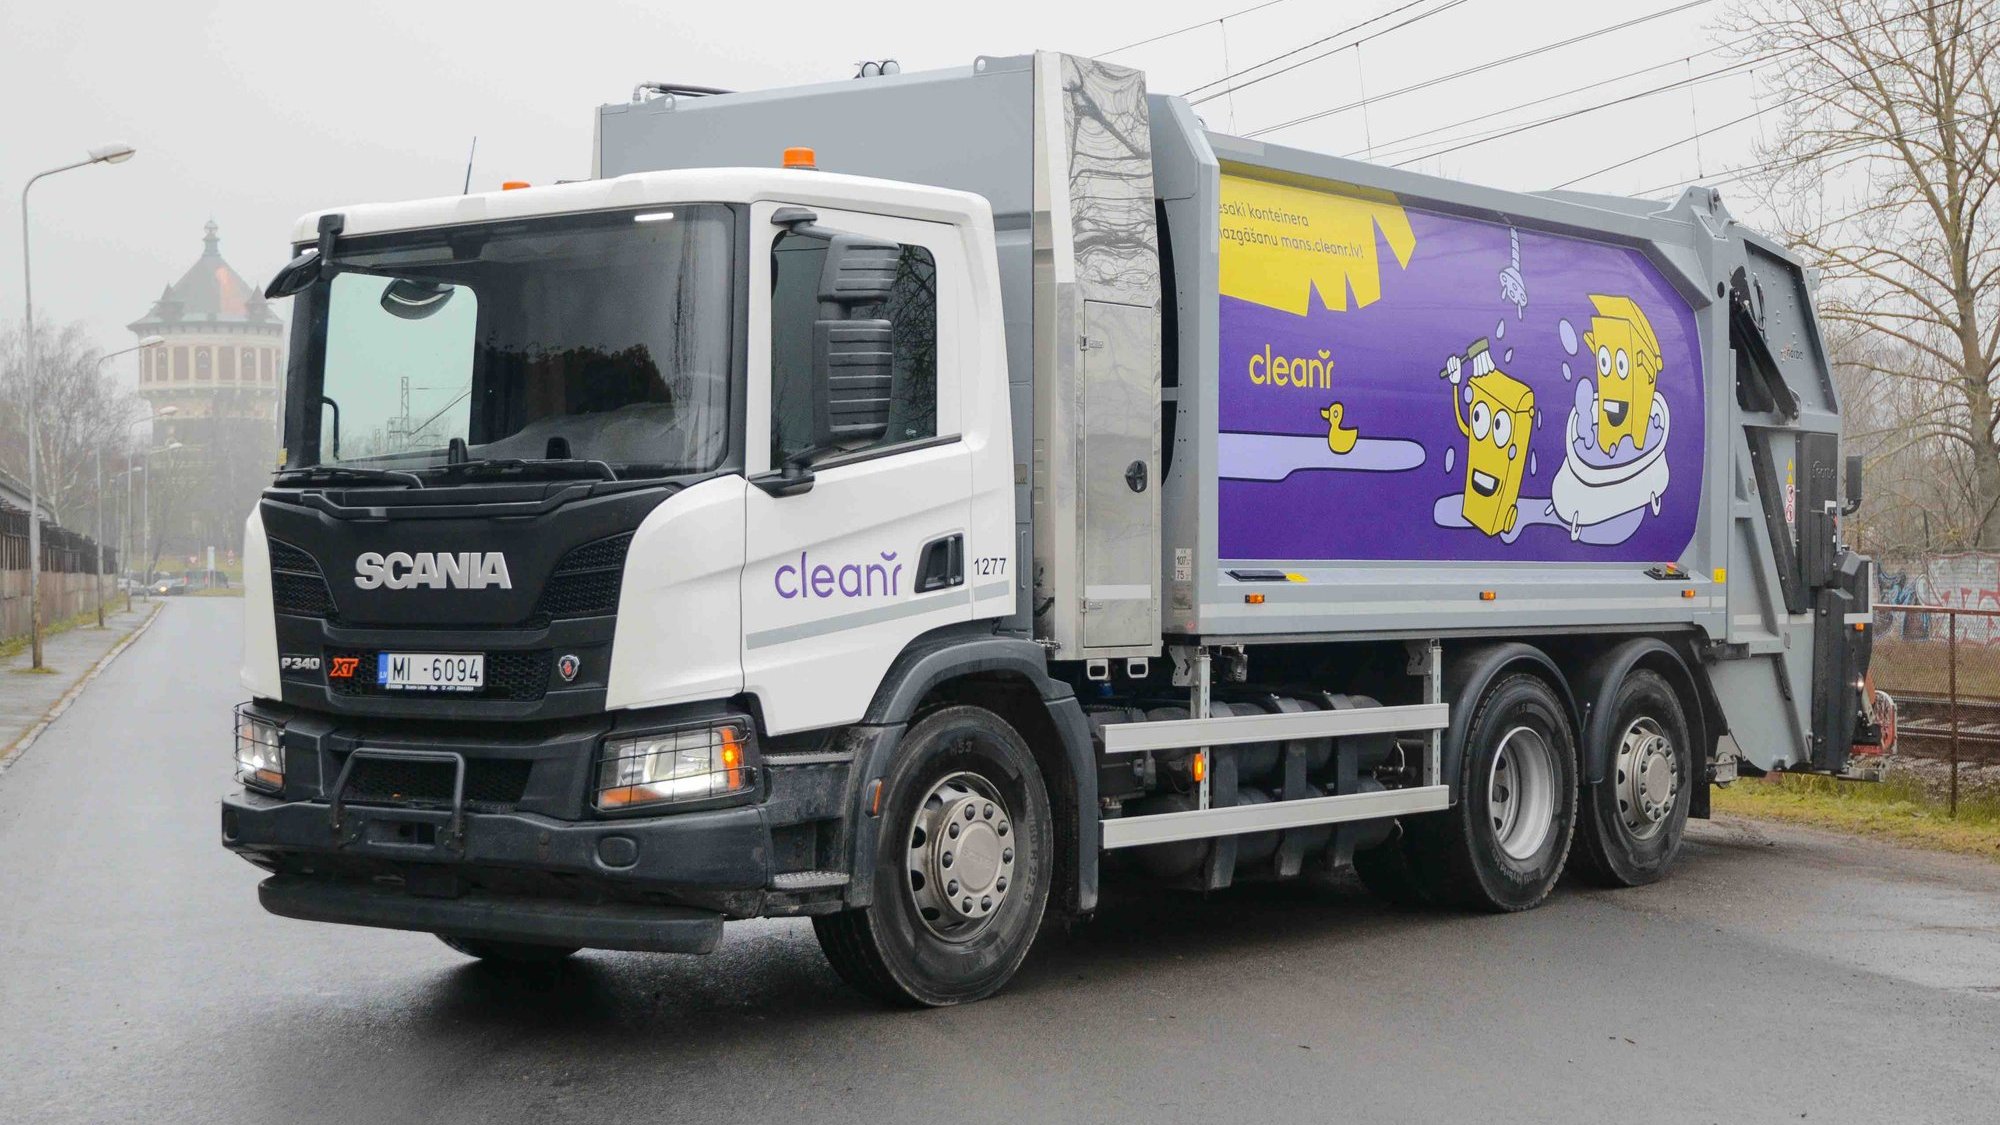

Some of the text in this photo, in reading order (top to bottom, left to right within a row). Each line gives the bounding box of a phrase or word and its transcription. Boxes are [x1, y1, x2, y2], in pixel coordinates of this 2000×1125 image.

[1248, 203, 1309, 227] konteinera
[1281, 234, 1364, 259] mans.cleanr.lv!
[354, 551, 512, 590] SCANIA
[973, 557, 1007, 576] 1277
[281, 657, 320, 670] P340
[329, 657, 360, 677] XT
